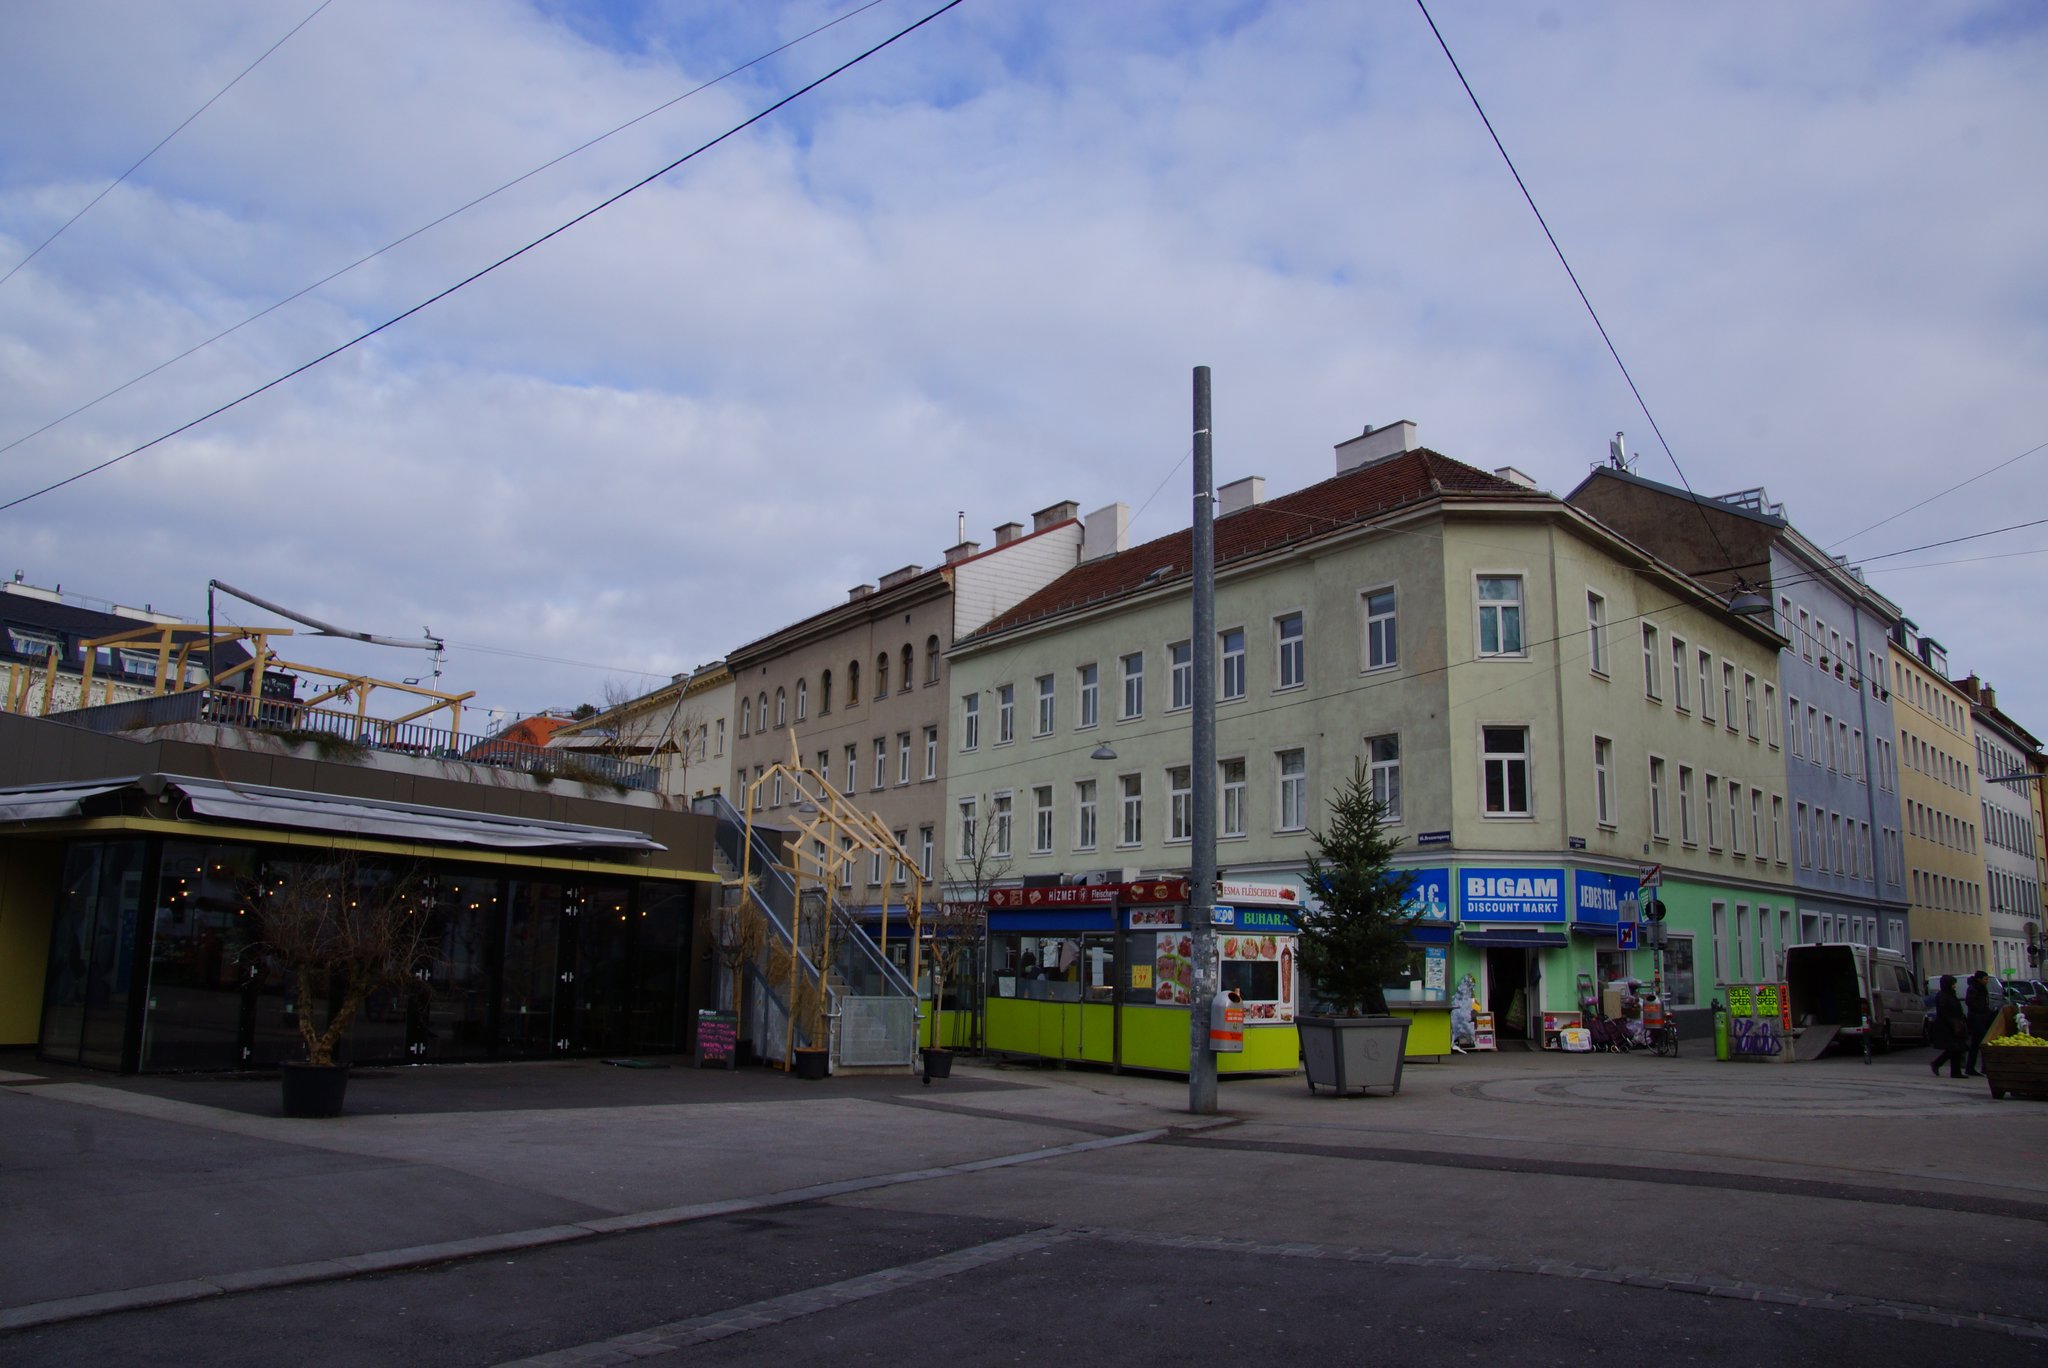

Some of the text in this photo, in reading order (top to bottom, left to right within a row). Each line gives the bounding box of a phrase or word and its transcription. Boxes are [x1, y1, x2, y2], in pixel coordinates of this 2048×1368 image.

[1223, 886, 1278, 898] ESMA FLEISCHEREI
[1467, 877, 1558, 897] BIGAM
[1580, 885, 1602, 910] JEDES
[1602, 888, 1618, 911] TEIL
[1468, 902, 1558, 913] DISCOUNT MARKT
[1243, 911, 1290, 926] BUHARA
[1730, 998, 1751, 1006] SPEER
[1757, 997, 1777, 1006] SPEER
